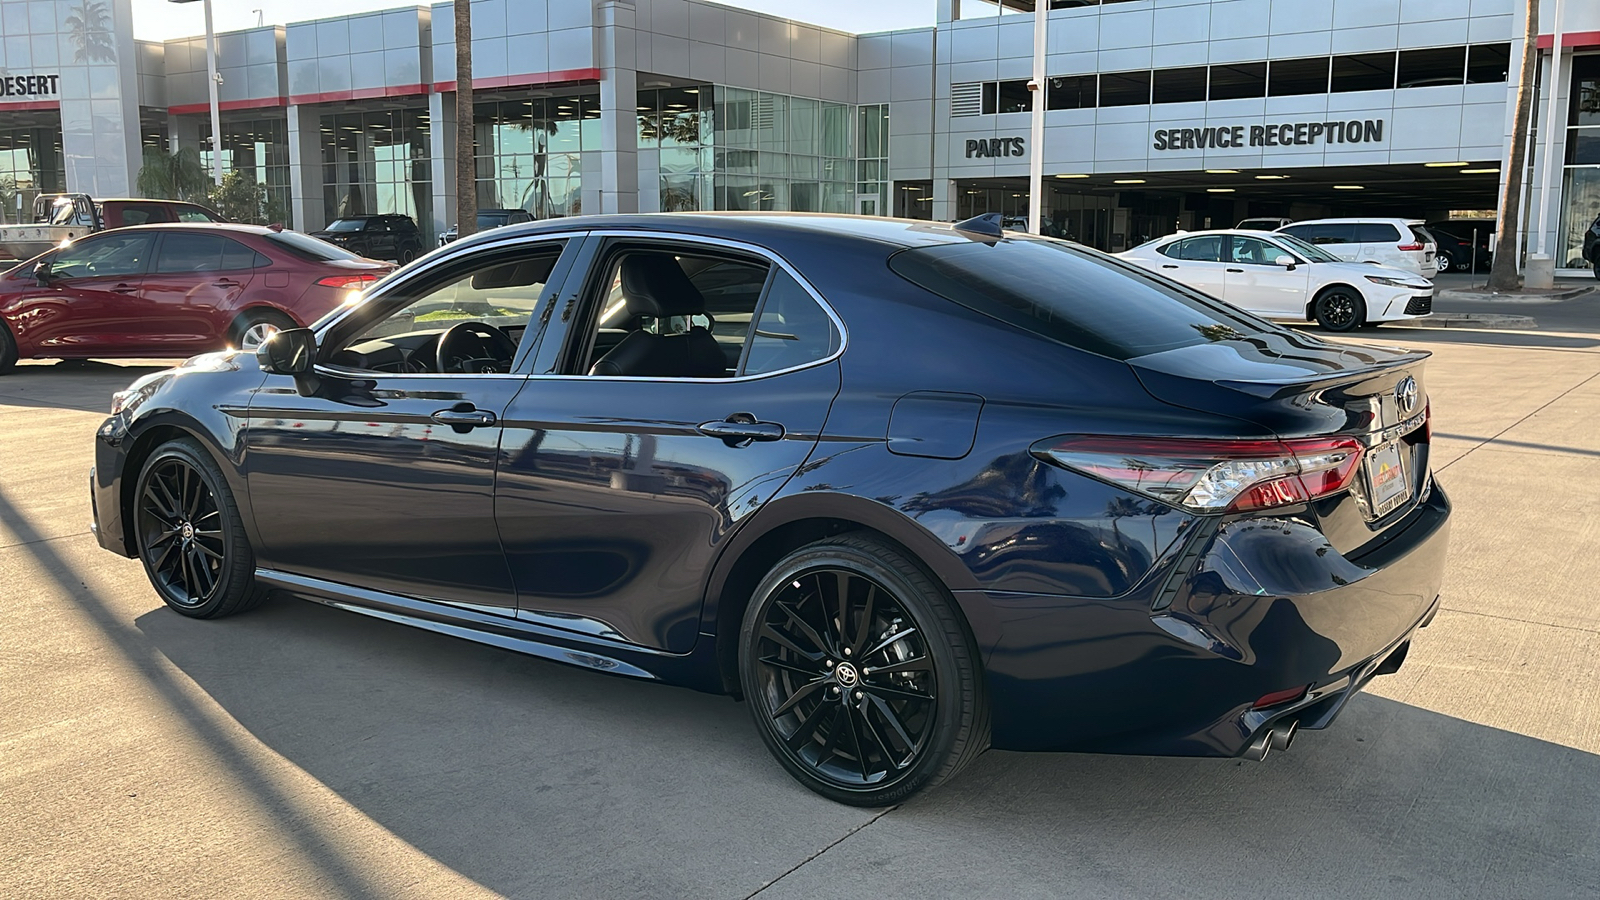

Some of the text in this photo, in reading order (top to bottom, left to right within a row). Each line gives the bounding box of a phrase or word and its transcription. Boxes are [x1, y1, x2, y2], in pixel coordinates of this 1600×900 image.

[965, 136, 1025, 158] PARTS
[1153, 119, 1383, 150] SERVICE RECEPTION
